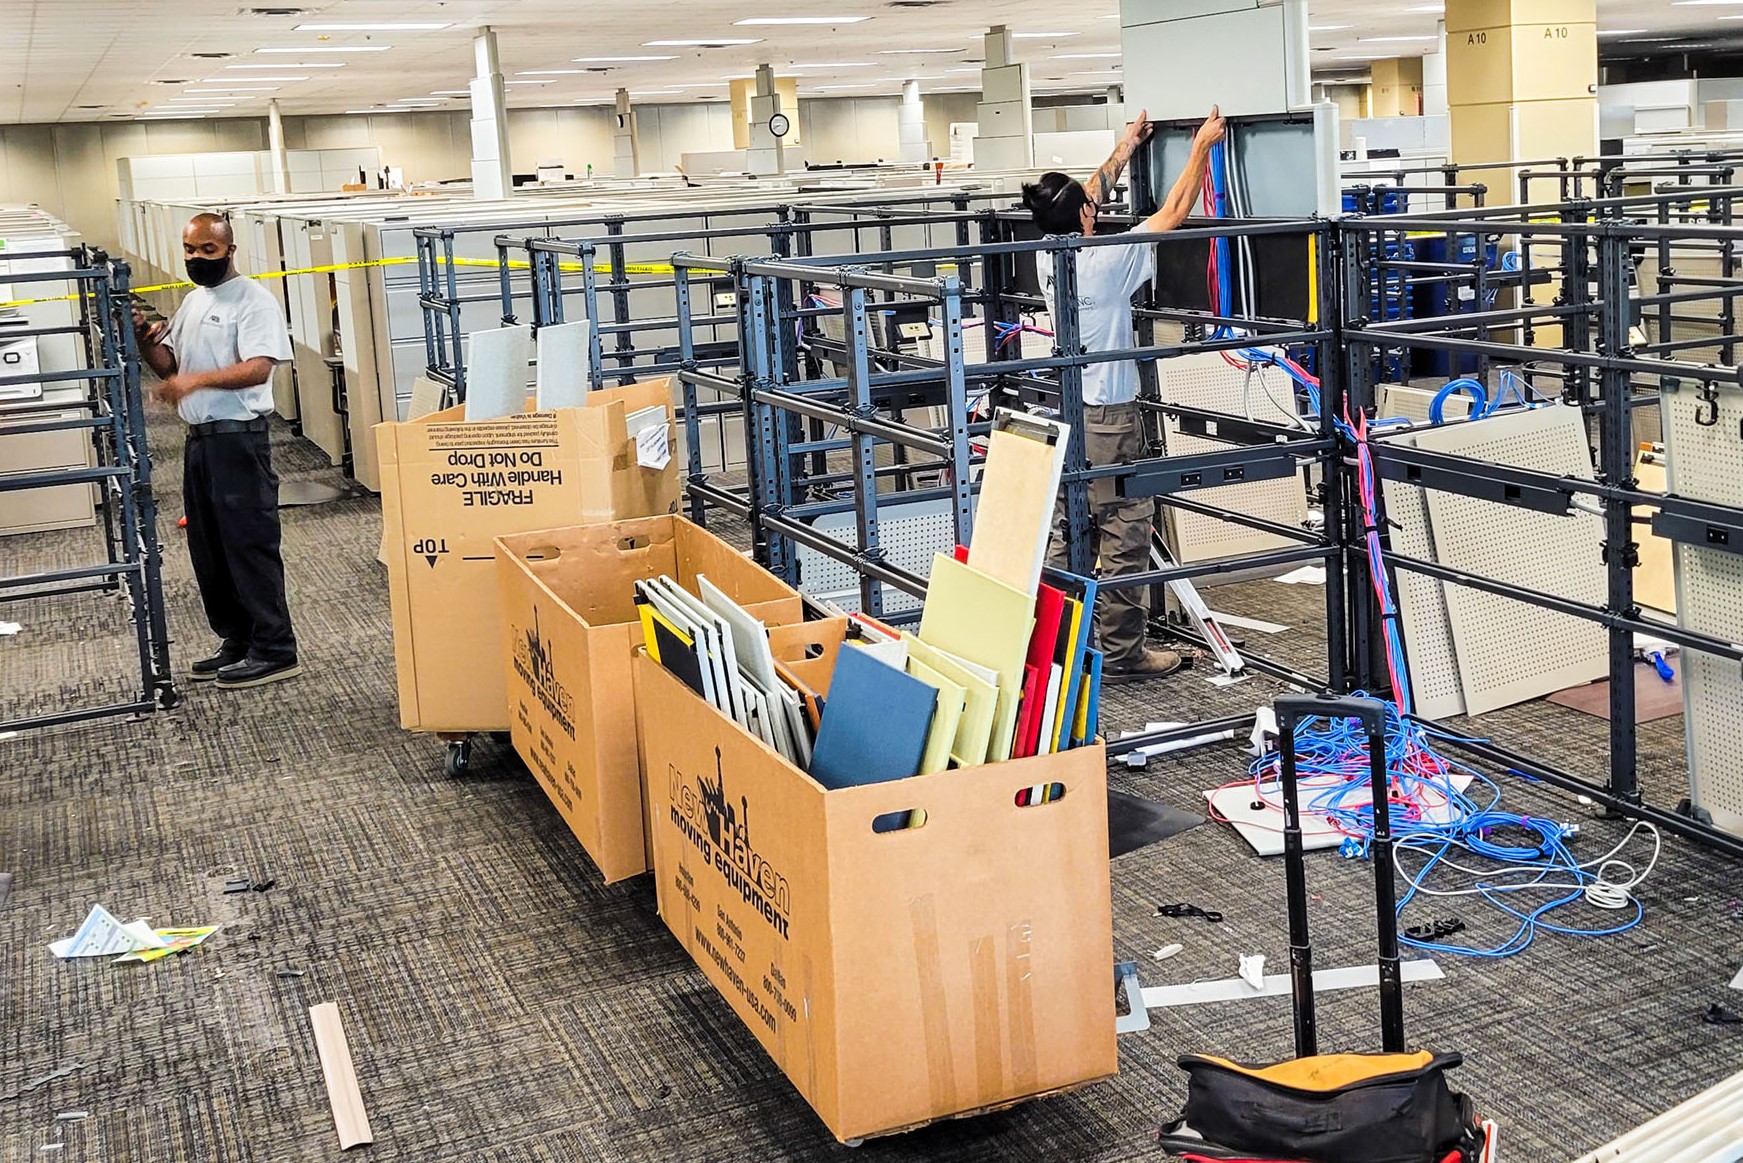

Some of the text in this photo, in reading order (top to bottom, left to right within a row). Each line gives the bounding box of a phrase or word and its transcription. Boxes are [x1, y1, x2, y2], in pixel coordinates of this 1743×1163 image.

[1476, 32, 1486, 44] 10
[1556, 27, 1568, 38] 10
[448, 451, 542, 468] Do Not Drop
[432, 470, 562, 488] Handle With Care
[464, 490, 533, 506] FRAGILE
[414, 539, 450, 554] TOP
[514, 656, 536, 697] moving
[537, 689, 576, 742] equipment
[668, 763, 790, 916] New Haven
[671, 804, 789, 940] moving equipment
[695, 926, 776, 1034] www.newhaven-usa.com
